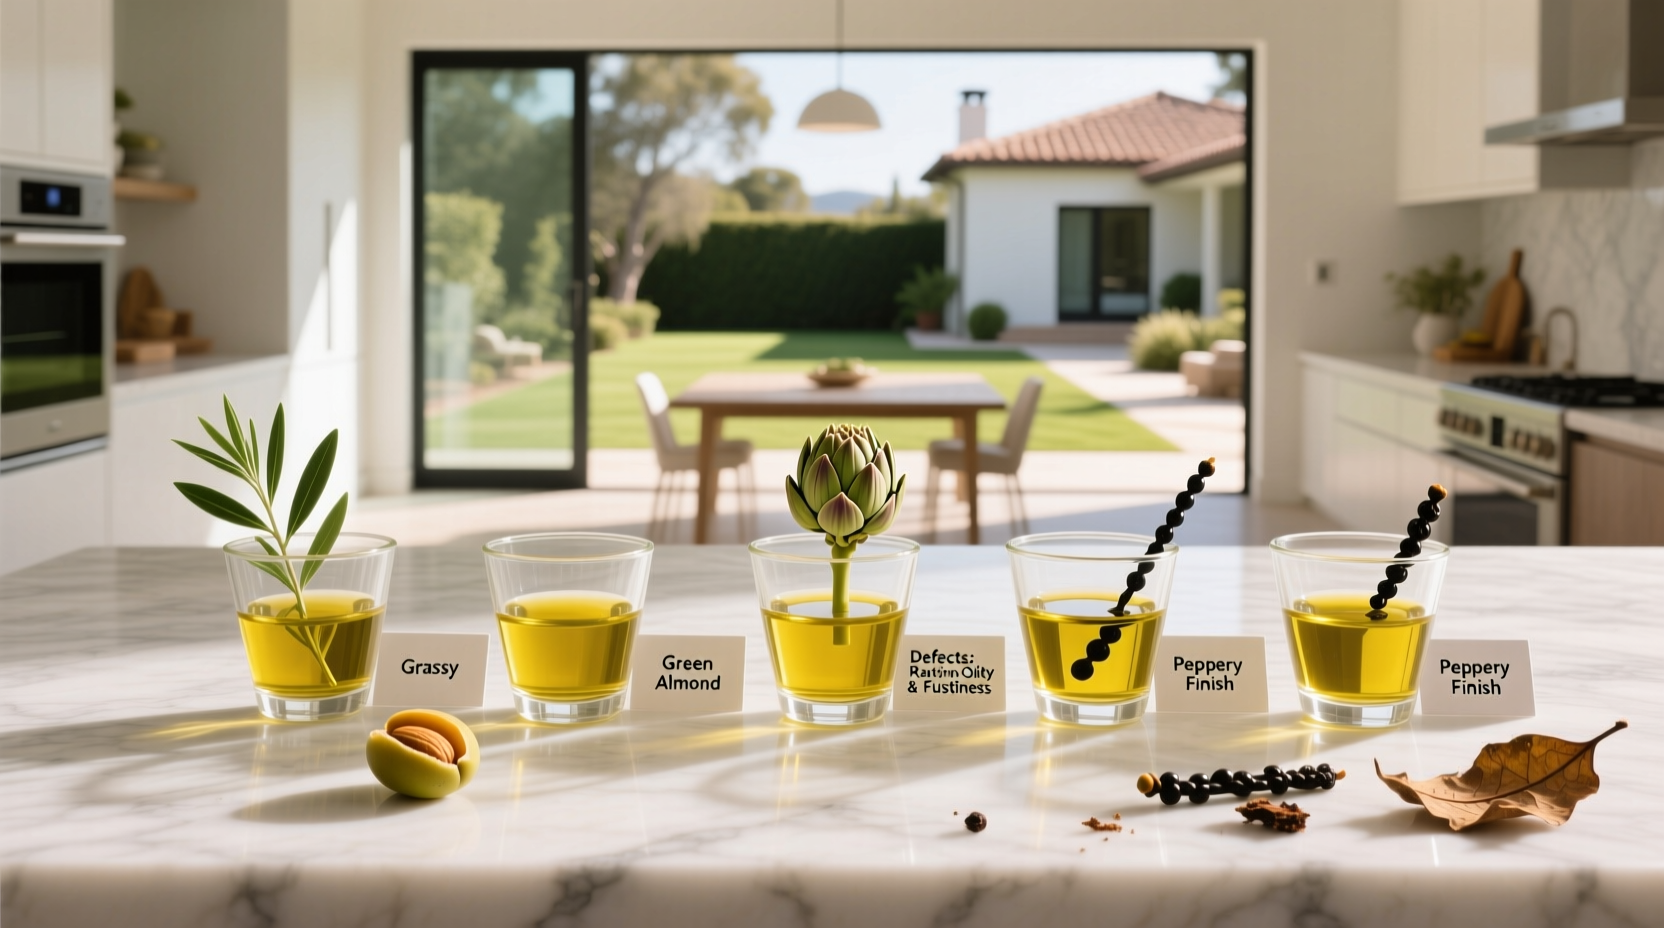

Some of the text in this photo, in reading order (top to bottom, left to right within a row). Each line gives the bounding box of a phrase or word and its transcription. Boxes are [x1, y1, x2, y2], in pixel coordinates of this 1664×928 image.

[662, 655, 713, 671] Green
[911, 649, 974, 664] Defects:
[401, 659, 459, 680] Grassy
[1173, 656, 1243, 675] Peppery
[1440, 659, 1510, 679] Peppery
[655, 674, 720, 690] Almond
[908, 680, 992, 694] & Fustiness
[1186, 676, 1234, 691] Finish
[1451, 679, 1501, 695] Finish
